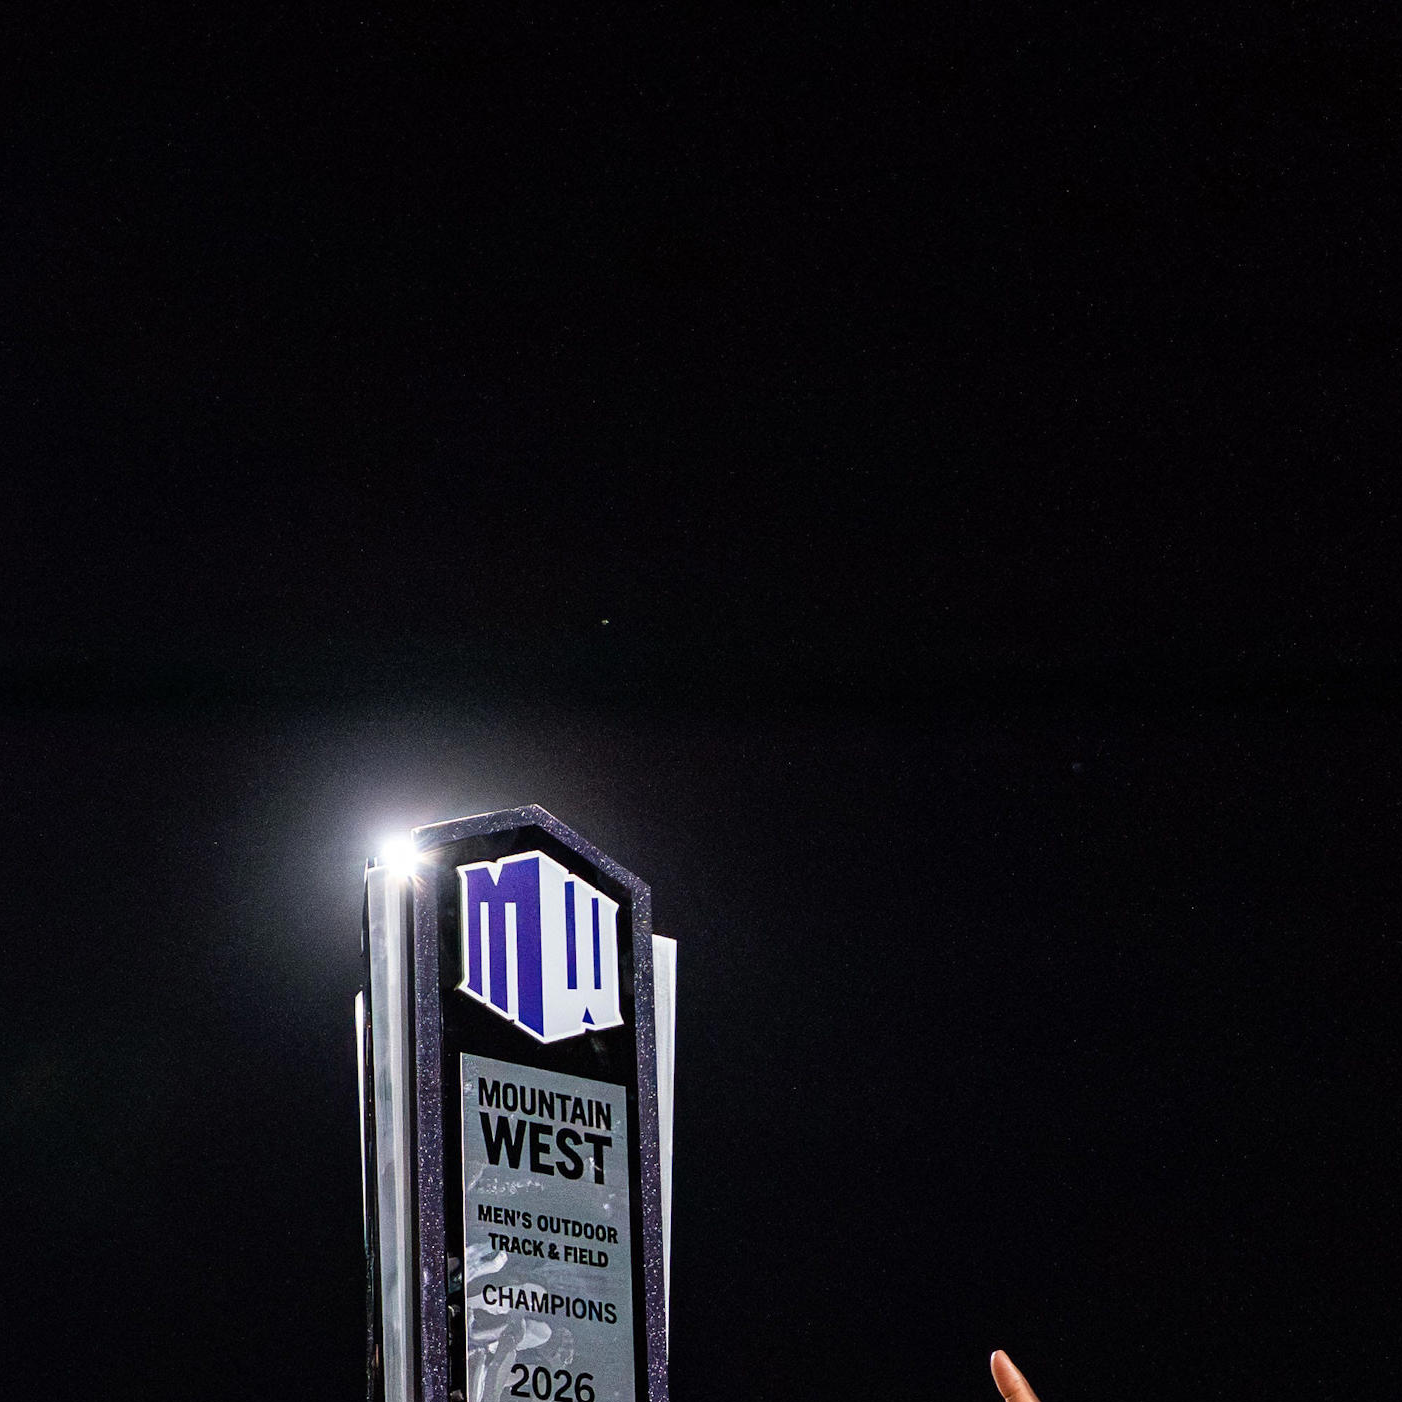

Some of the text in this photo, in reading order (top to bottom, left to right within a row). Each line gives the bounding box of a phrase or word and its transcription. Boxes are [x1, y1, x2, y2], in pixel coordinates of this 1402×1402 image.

[478, 1076, 612, 1131] MOUNTAIN
[479, 1111, 613, 1186] WEST
[478, 1204, 619, 1245] MEN'S OUTDOOR
[488, 1232, 609, 1268] TRACK & FIELD
[482, 1284, 618, 1325] CHAMPIONS
